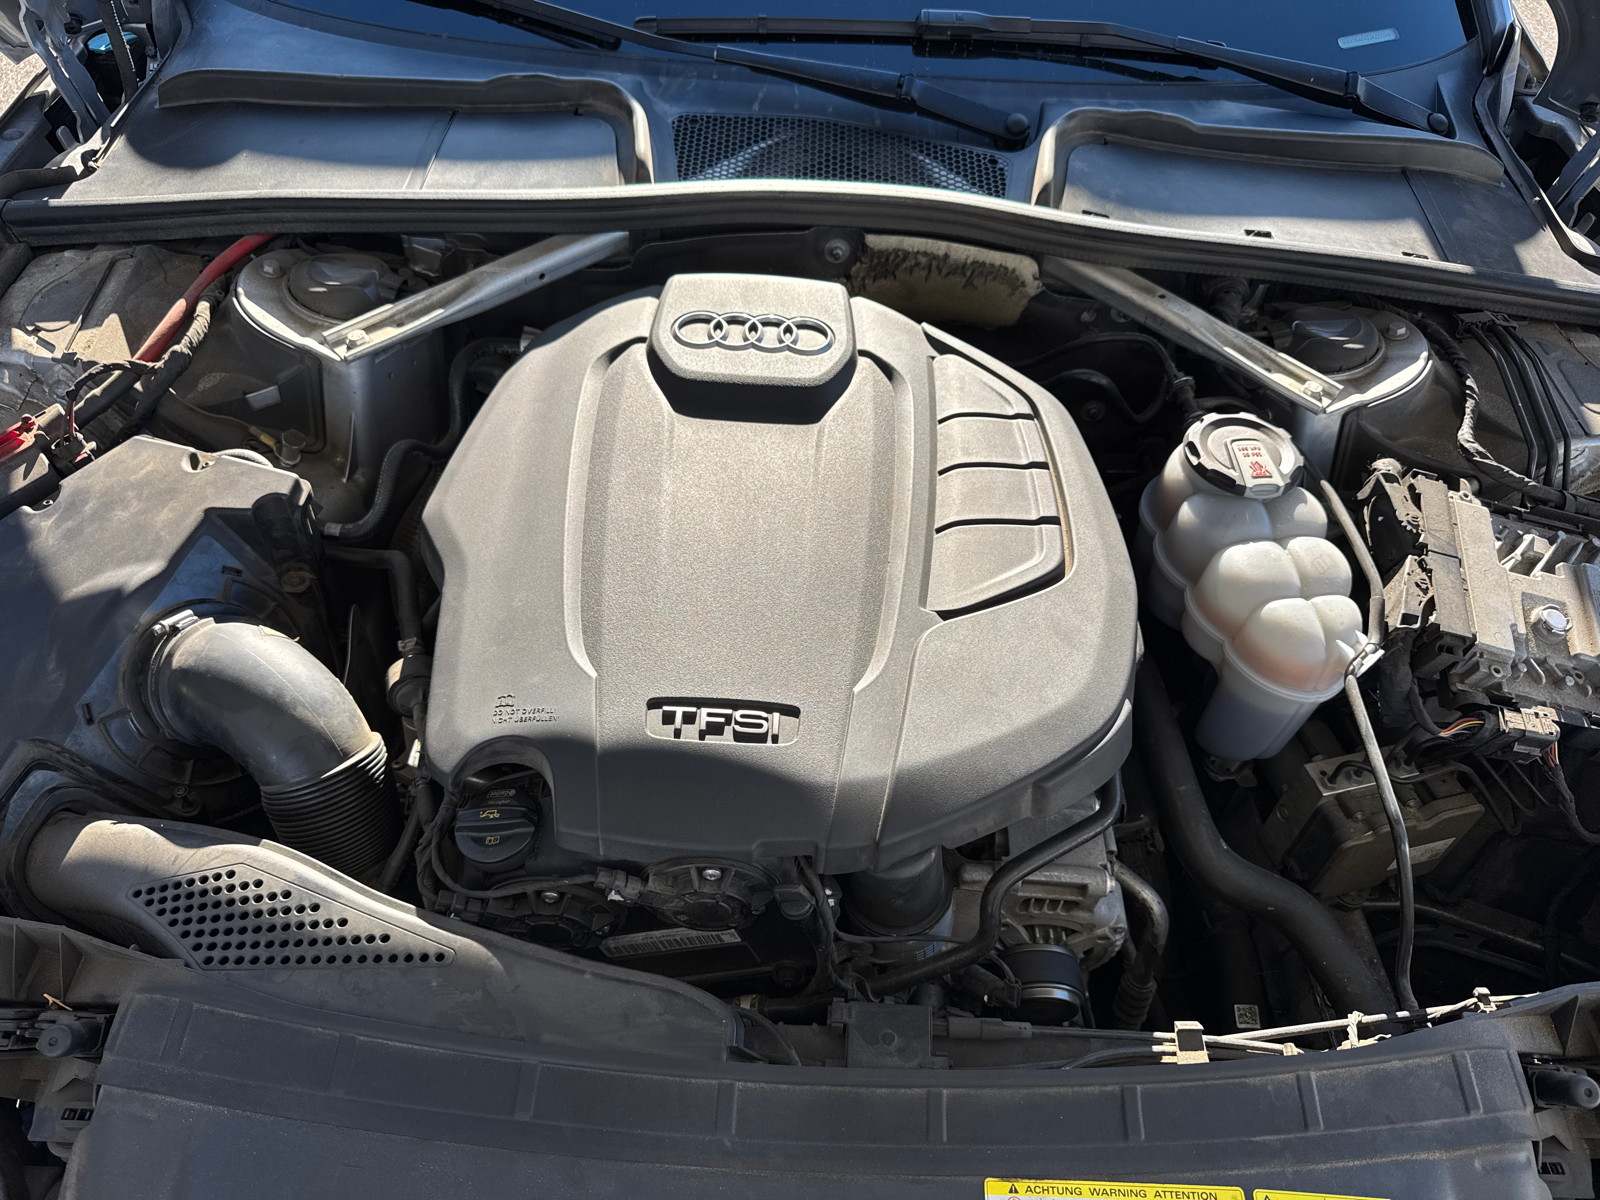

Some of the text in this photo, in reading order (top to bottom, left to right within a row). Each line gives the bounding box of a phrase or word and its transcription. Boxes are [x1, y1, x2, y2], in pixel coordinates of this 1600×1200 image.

[505, 708, 520, 716] NOT
[662, 705, 781, 737] TFSI
[1025, 1185, 1218, 1200] ACHTUNG WARNING ATTENTION
